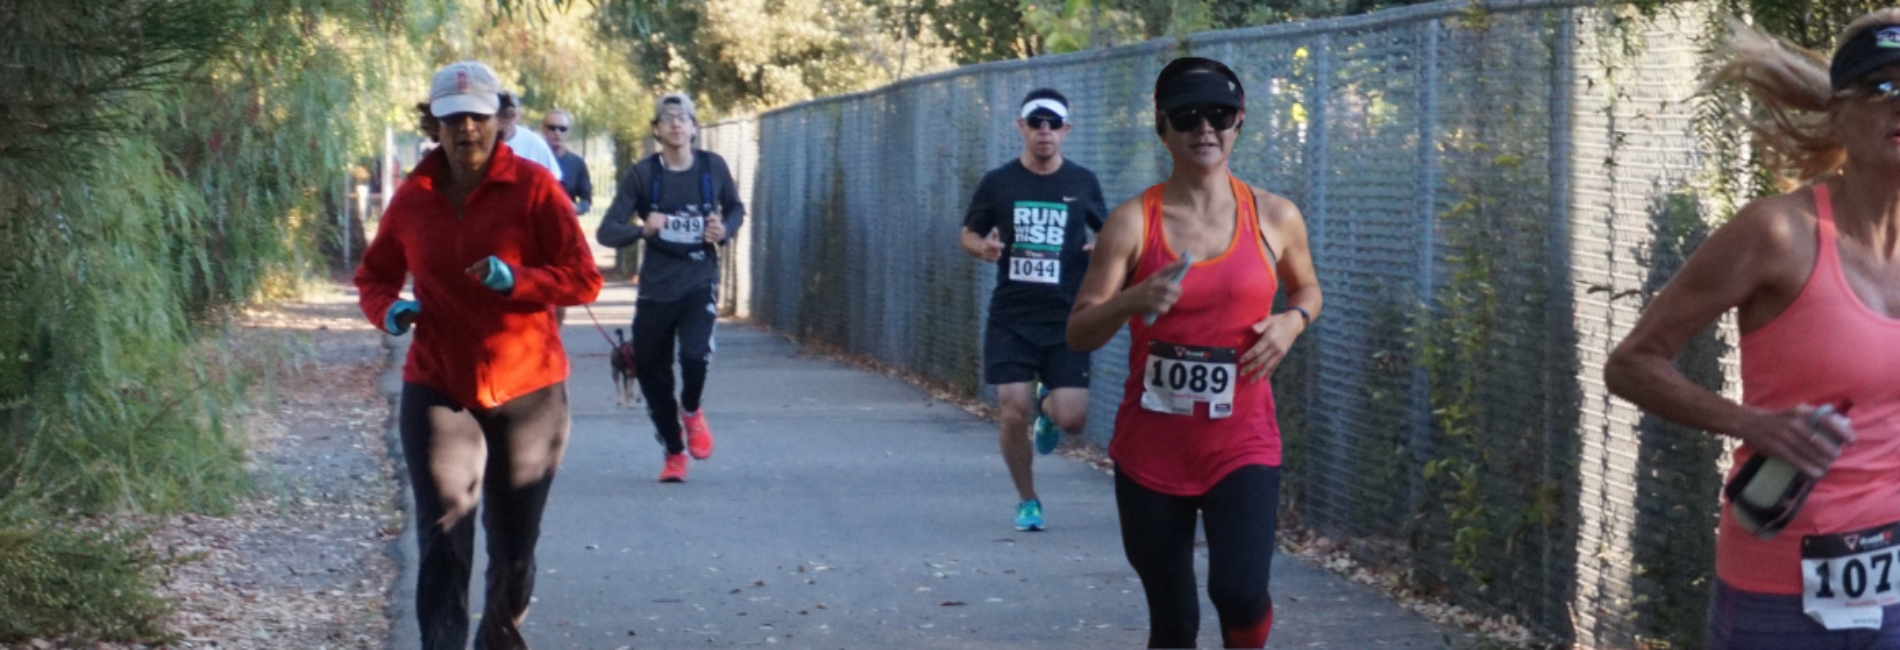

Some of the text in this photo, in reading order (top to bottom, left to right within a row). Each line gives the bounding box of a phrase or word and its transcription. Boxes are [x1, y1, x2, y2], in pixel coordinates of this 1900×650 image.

[1013, 207, 1068, 227] RUN
[1029, 225, 1064, 245] SB
[1013, 259, 1055, 277] 1044
[1151, 360, 1228, 394] 1089
[1815, 549, 1900, 599] 107
